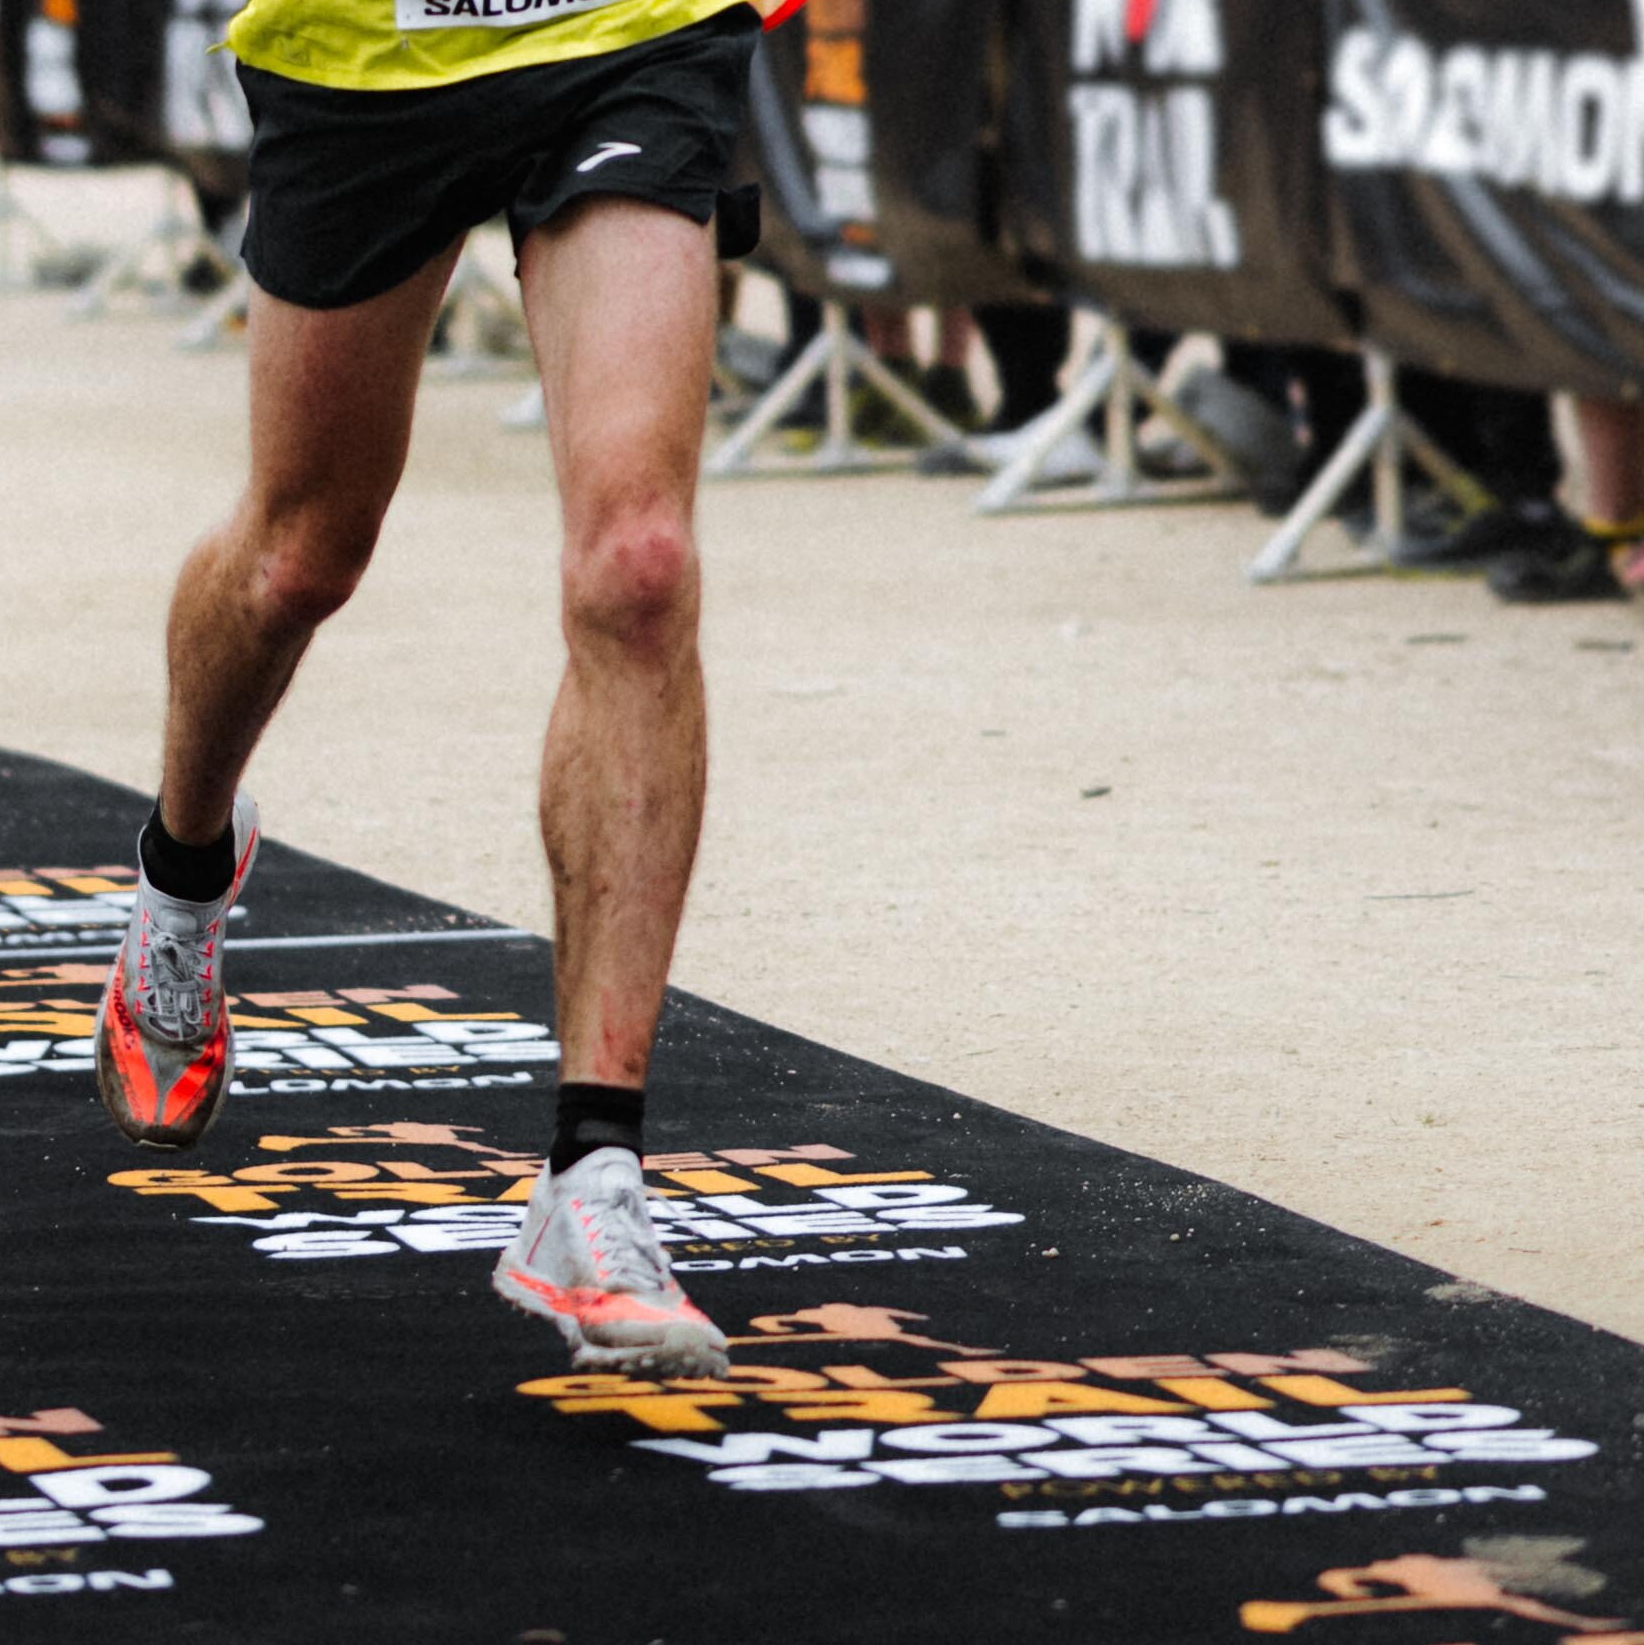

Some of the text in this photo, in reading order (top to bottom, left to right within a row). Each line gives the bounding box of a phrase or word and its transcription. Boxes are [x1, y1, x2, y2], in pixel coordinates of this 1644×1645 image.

[227, 1071, 535, 1095] LOMON
[668, 1246, 970, 1272] OMON
[553, 1374, 1473, 1433] TRAIL
[629, 1403, 1522, 1465] WORLD
[706, 1428, 1601, 1490] SERIES
[997, 1484, 1546, 1528] SALOMON
